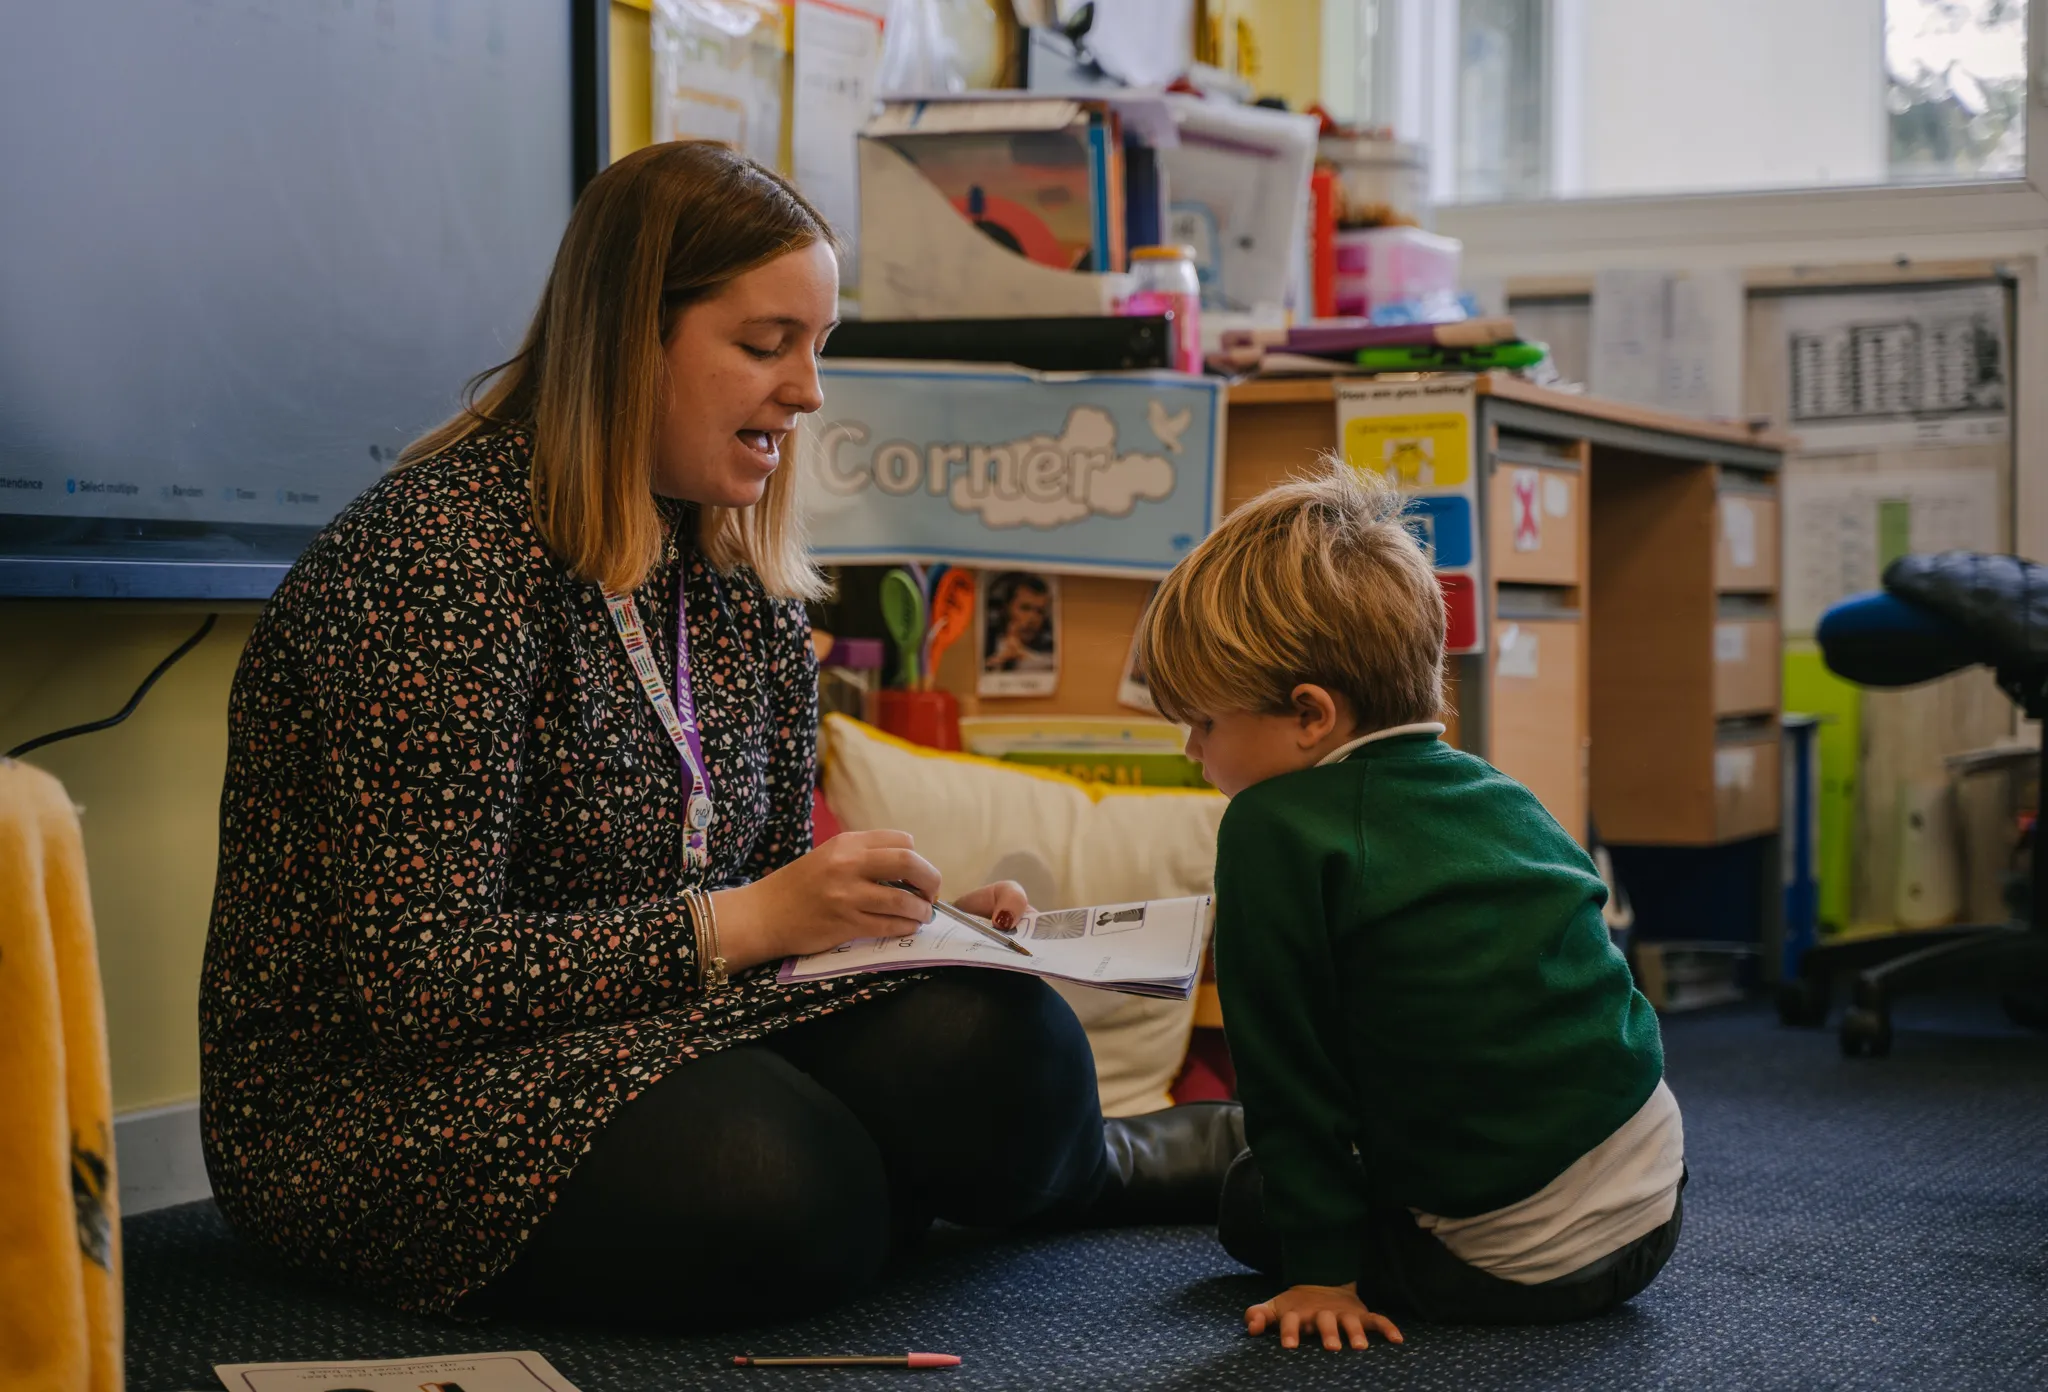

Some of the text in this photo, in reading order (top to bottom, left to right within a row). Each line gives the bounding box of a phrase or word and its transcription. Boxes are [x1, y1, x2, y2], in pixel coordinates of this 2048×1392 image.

[80, 480, 105, 493] Select
[817, 418, 1111, 503] Corner
[680, 676, 695, 734] Miss
